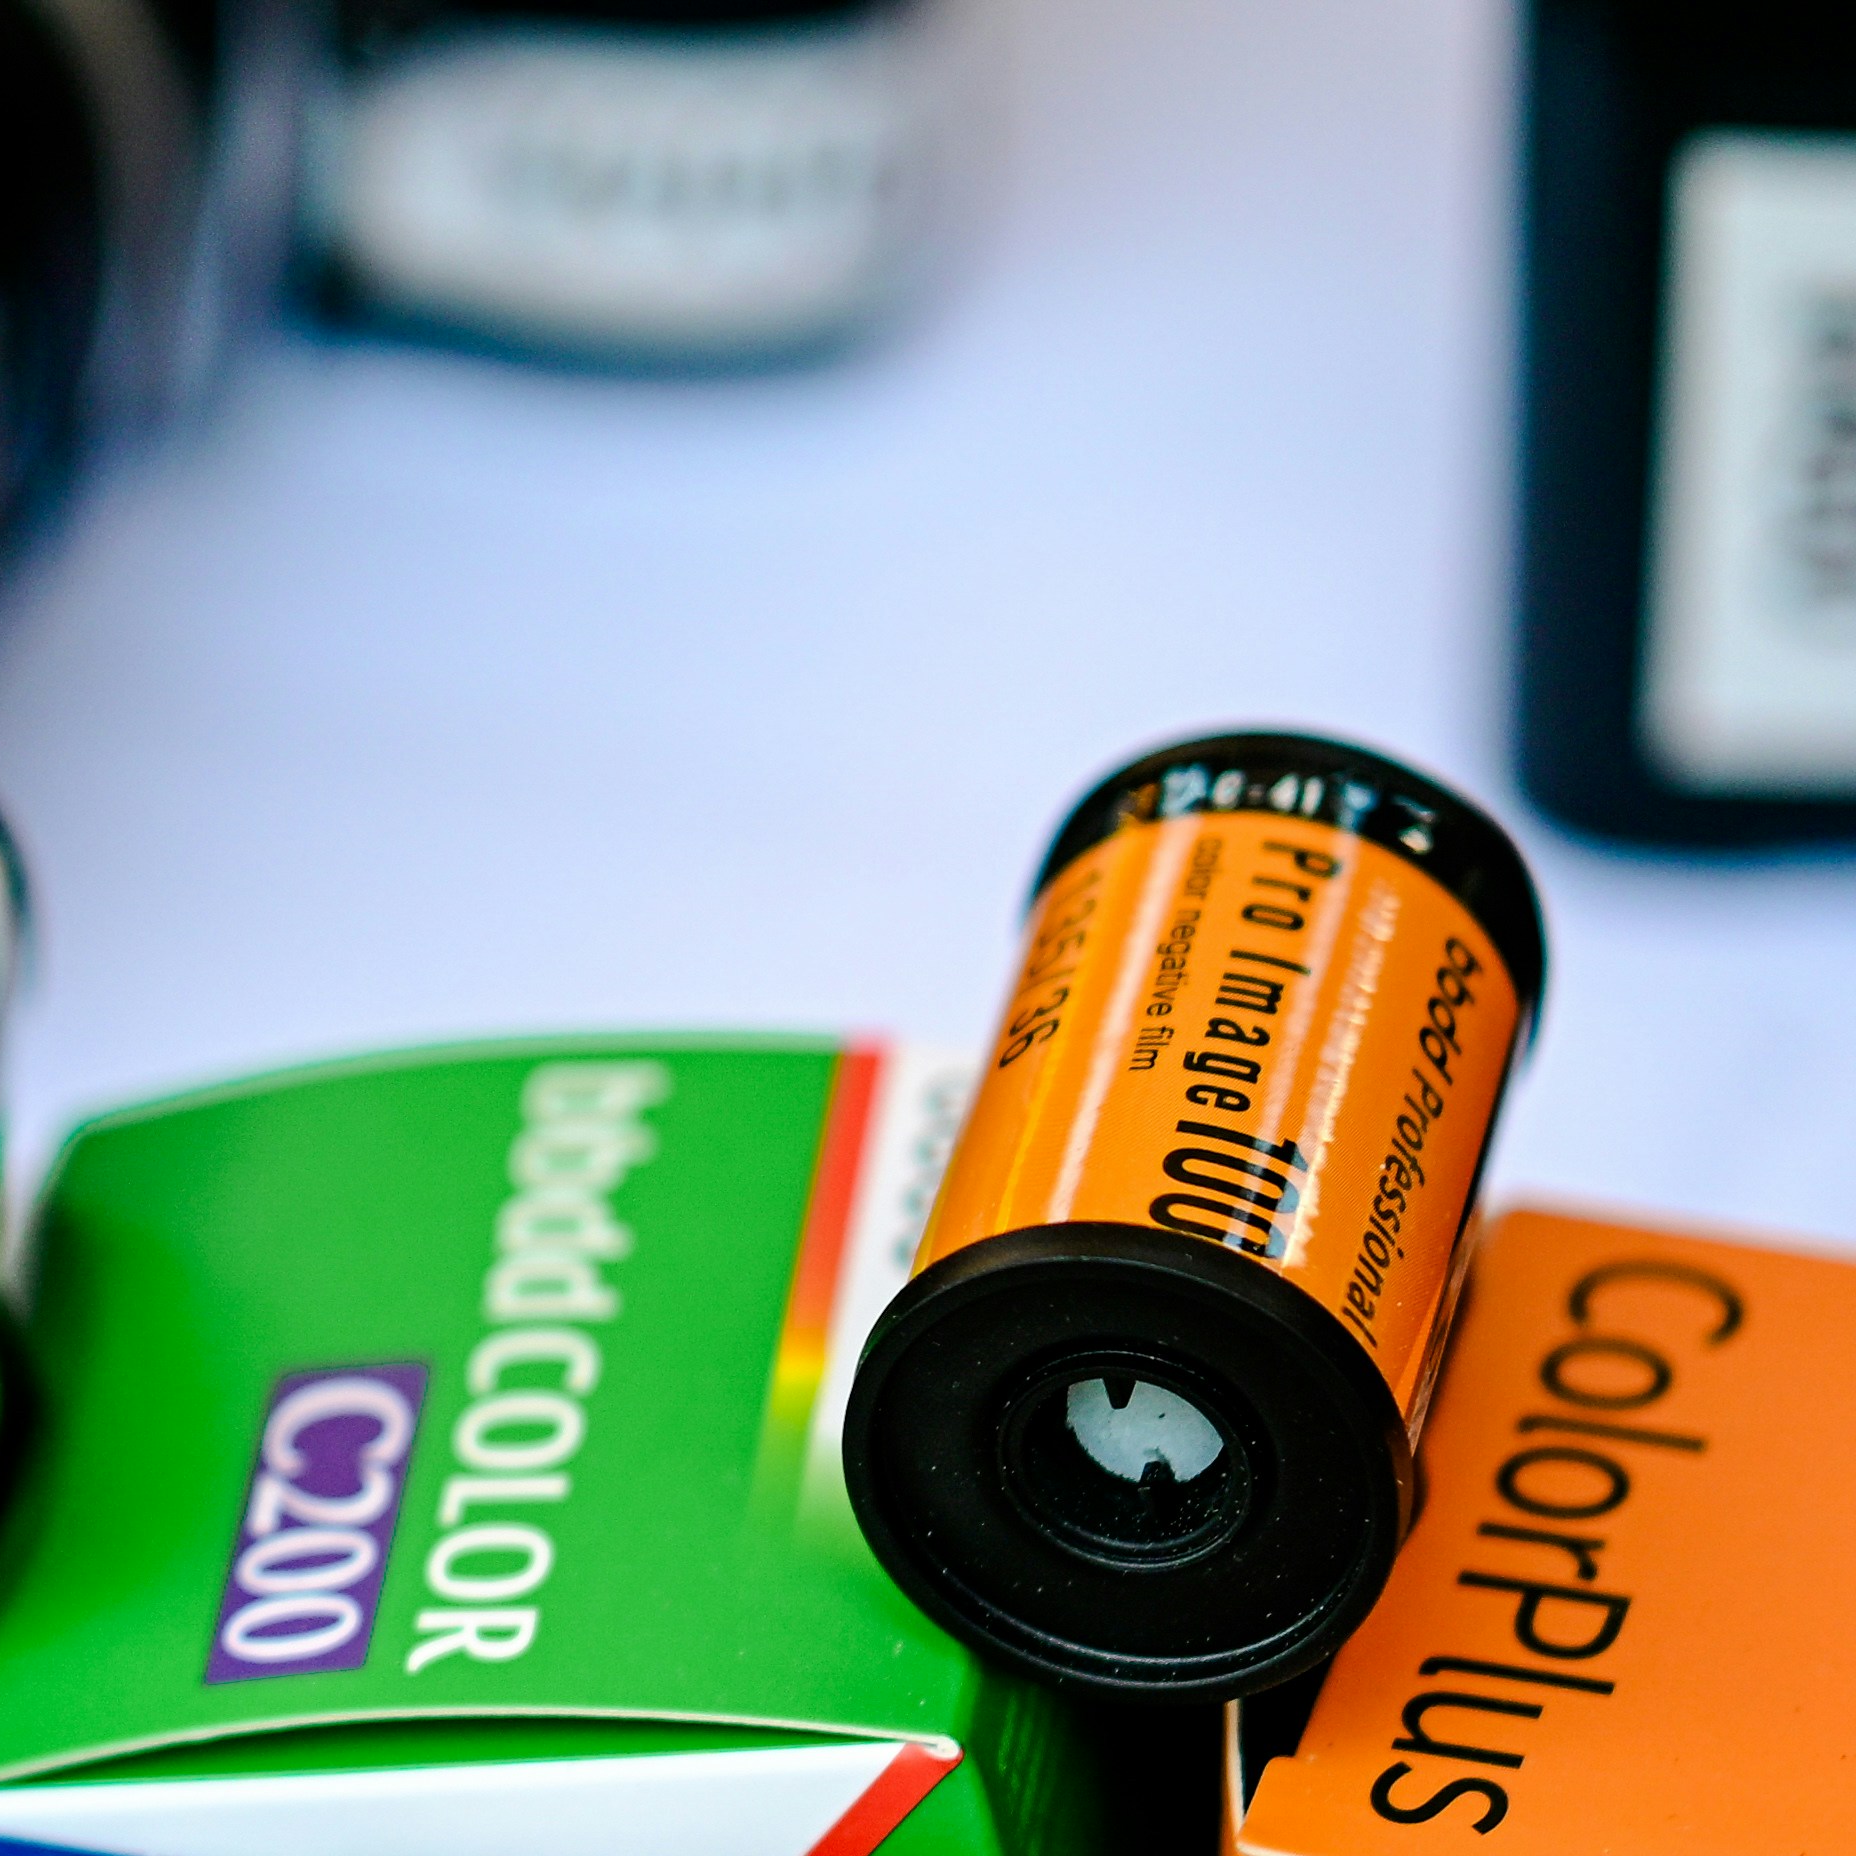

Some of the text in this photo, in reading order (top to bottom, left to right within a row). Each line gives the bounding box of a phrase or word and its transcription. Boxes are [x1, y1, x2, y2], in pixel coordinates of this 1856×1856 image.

[1148, 910, 1210, 1017] negative
[1241, 838, 1344, 931] Pro
[1128, 1023, 1176, 1073] film
[1185, 945, 1312, 1114] Image
[1340, 1066, 1449, 1348] Professional
[218, 1376, 416, 1664] C200
[1368, 1258, 1745, 1836] ColorPlus
